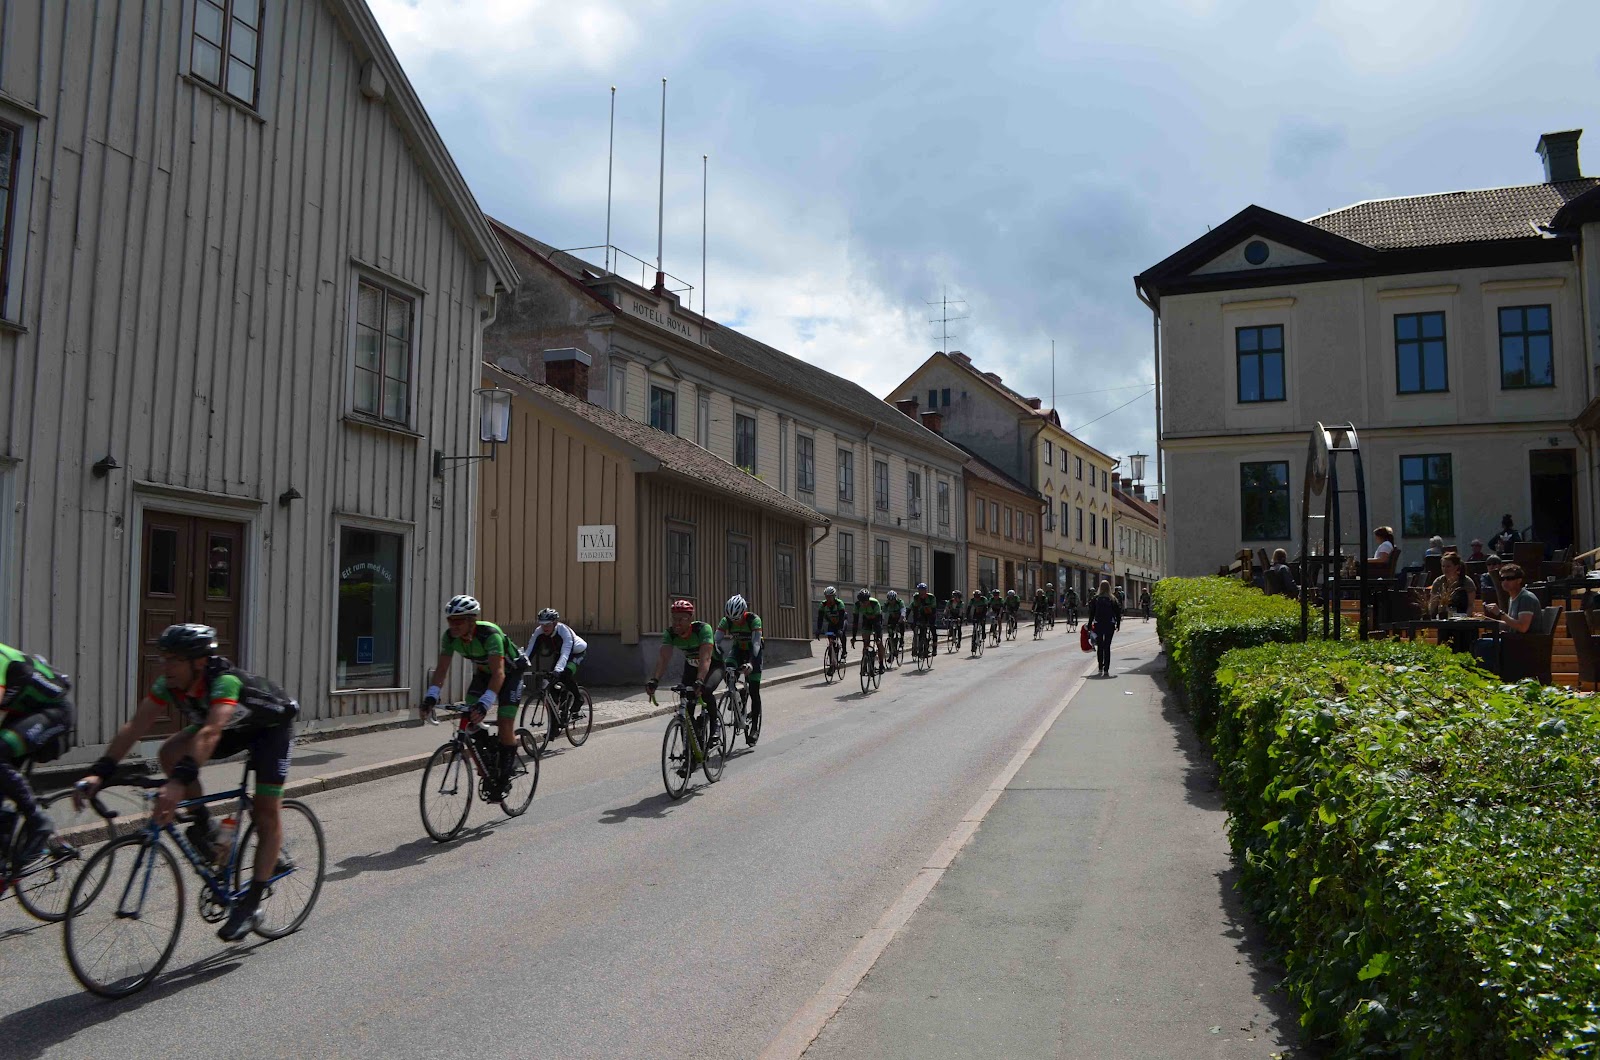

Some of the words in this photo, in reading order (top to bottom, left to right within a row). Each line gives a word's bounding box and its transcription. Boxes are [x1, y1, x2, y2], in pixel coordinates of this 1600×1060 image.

[633, 301, 664, 325] HOTELL
[666, 316, 692, 337] ROYAL
[580, 529, 614, 548] TVÅL
[580, 551, 614, 559] FABRIKEN
[341, 566, 352, 579] Ett
[352, 562, 366, 572] rum
[367, 562, 381, 573] med
